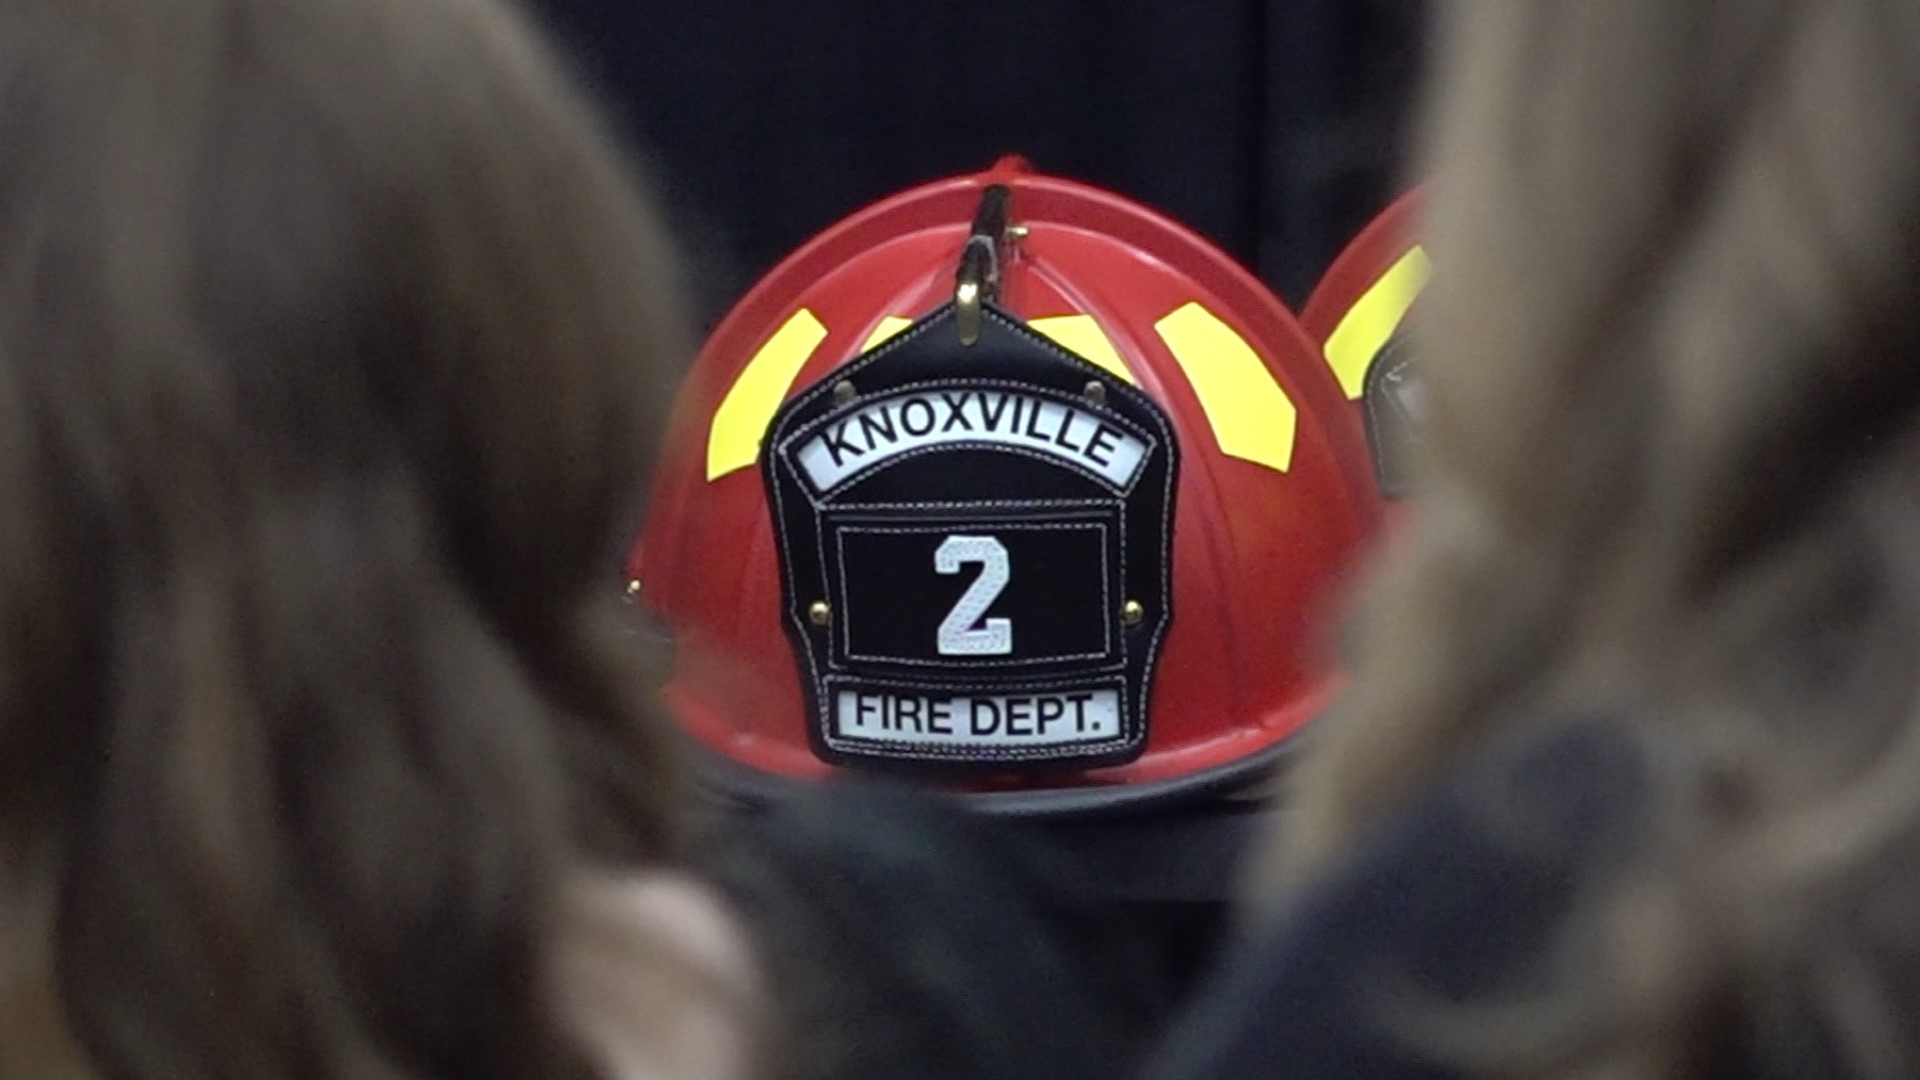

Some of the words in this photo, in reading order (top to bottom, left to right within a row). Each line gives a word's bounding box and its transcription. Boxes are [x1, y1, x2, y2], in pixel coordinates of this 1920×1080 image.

[820, 391, 1124, 468] KNOXVILLE
[934, 534, 1012, 656] 2
[855, 691, 953, 735] FIRE
[970, 692, 1101, 737] DEPT.
